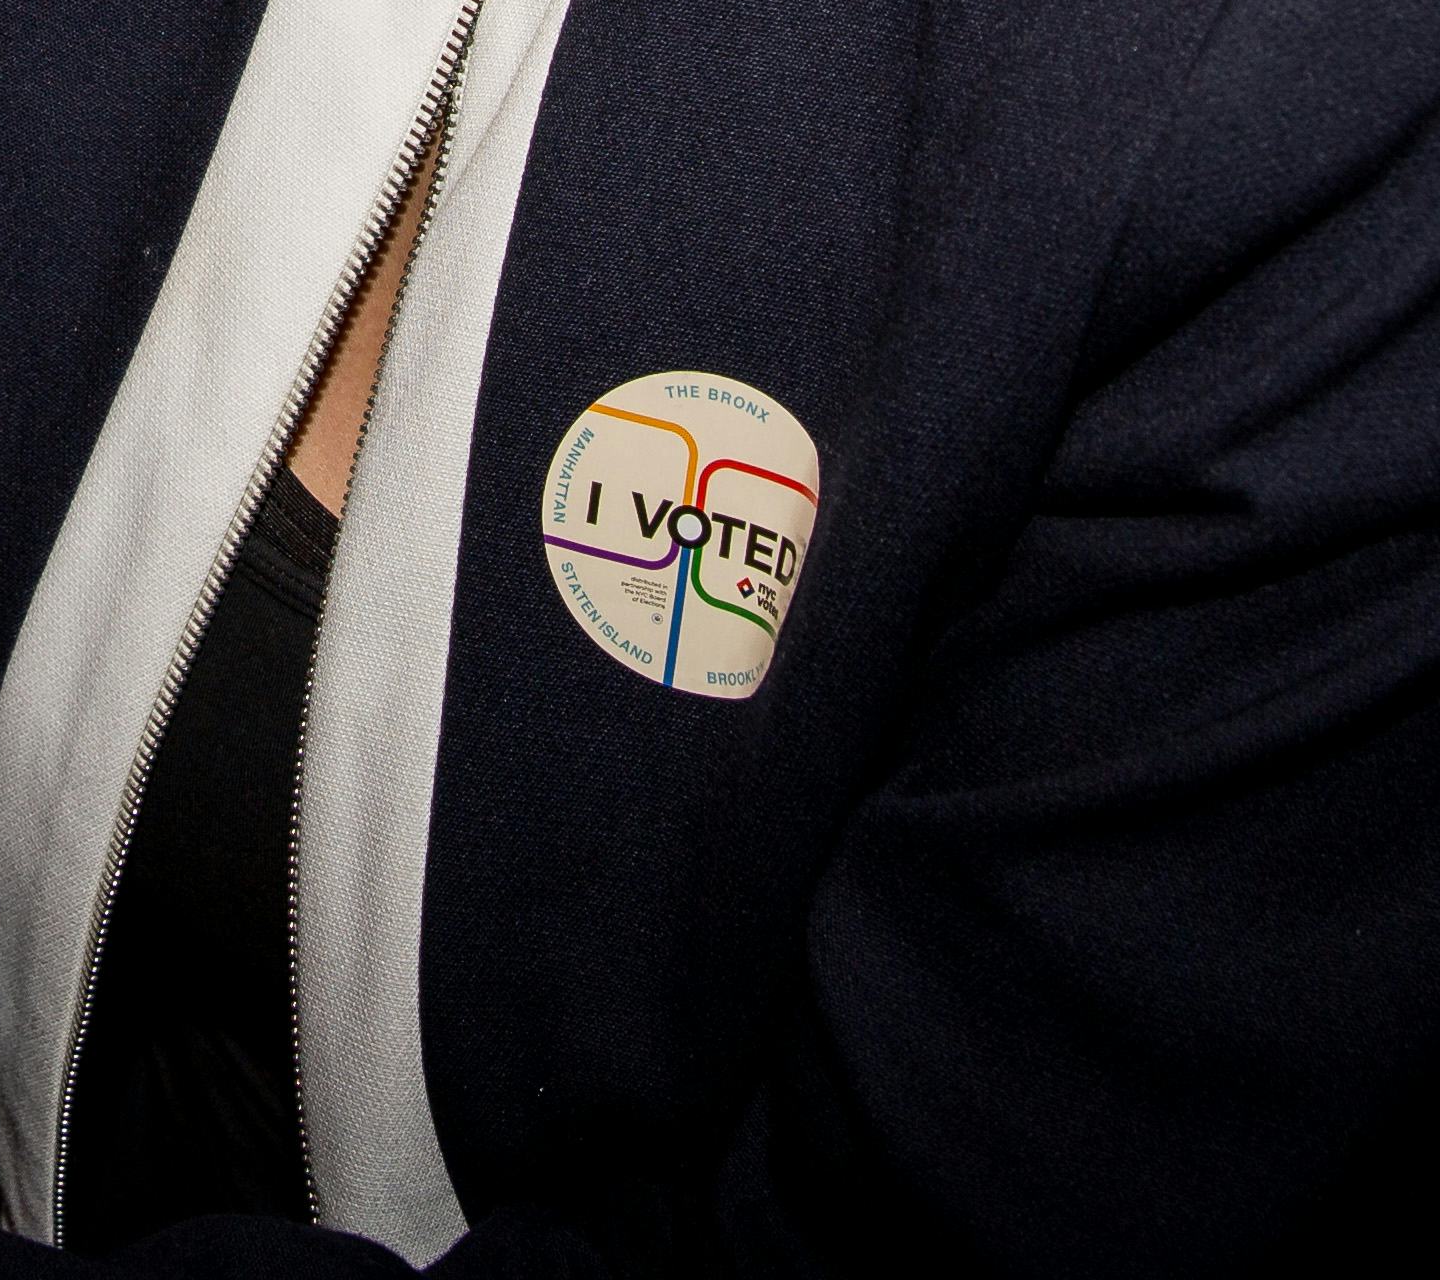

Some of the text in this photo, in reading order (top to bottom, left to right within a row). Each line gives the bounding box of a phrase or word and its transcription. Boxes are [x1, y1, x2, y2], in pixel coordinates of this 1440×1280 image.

[664, 384, 770, 424] THE BRONX
[553, 426, 595, 524] MANHATTAN
[586, 481, 797, 587] I VOTED
[560, 561, 653, 666] STATEN ISLAND
[757, 582, 777, 601] nyc
